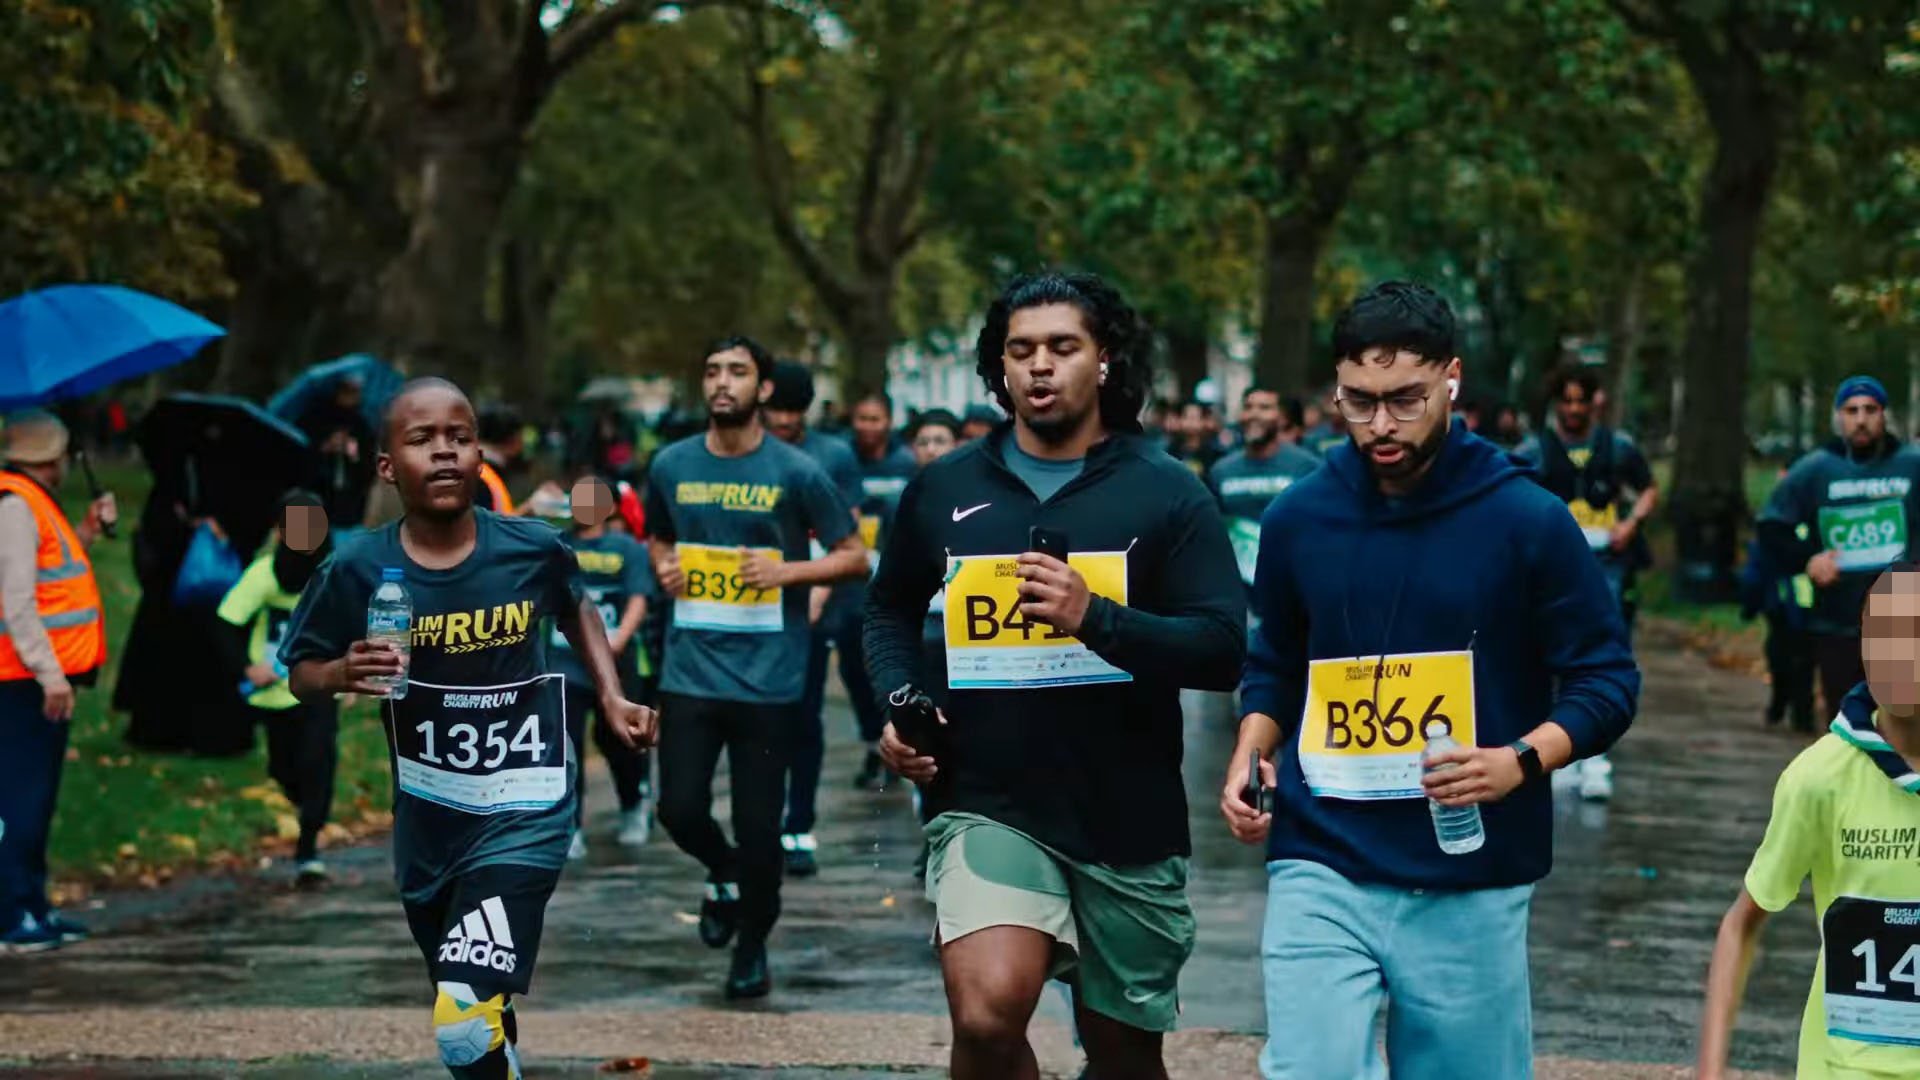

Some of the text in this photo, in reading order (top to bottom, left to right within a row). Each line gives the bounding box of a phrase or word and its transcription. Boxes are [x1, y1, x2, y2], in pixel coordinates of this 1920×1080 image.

[1829, 519, 1896, 549] C689
[444, 601, 531, 645] RUN
[966, 595, 1071, 641] B4
[1373, 662, 1412, 679] RUN
[480, 691, 518, 709] RUN
[1324, 694, 1453, 749] B366
[415, 714, 546, 769] 1354
[1841, 827, 1917, 844] MUSLIM
[1841, 844, 1914, 860] CHARITY
